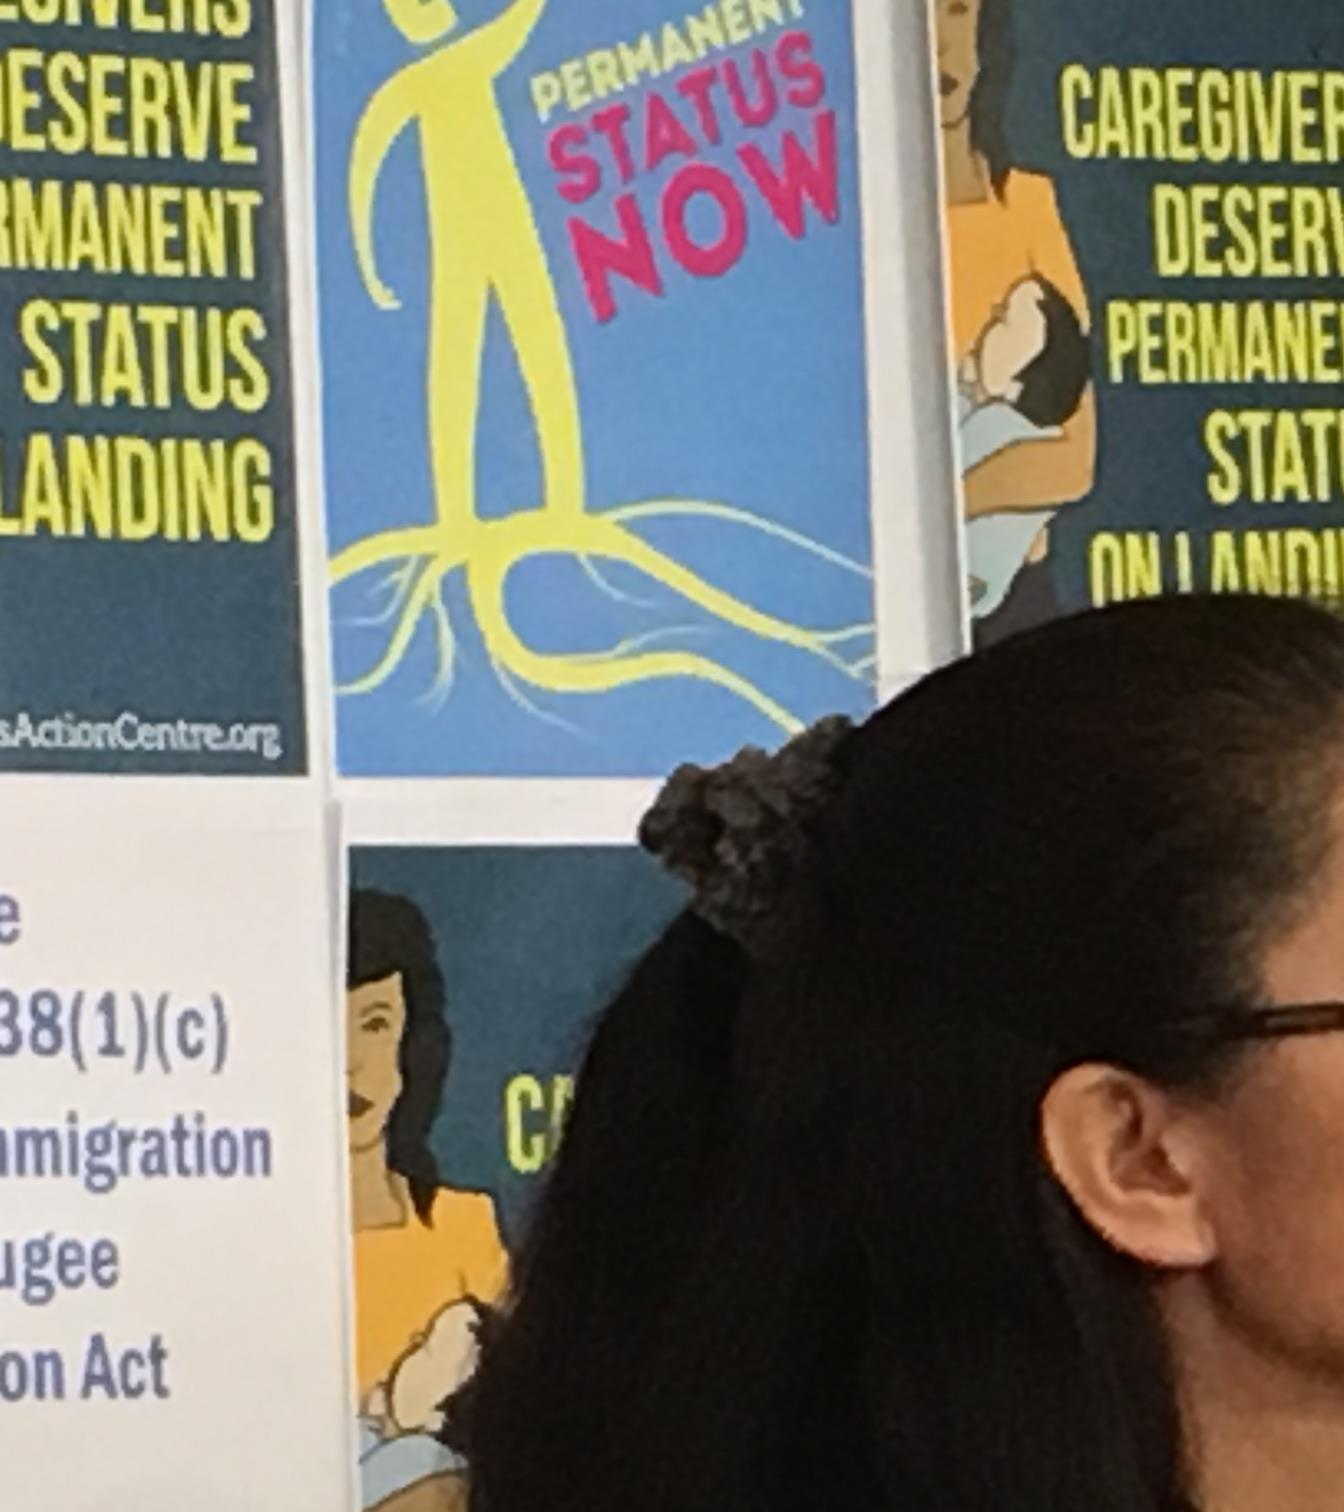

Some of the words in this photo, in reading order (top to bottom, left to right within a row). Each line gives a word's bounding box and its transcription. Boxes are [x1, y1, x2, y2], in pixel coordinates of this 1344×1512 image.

[0, 48, 257, 163] ESERVE
[548, 30, 826, 204] STATUS
[566, 109, 840, 324] NOW
[20, 299, 270, 413] STATUS
[1091, 531, 1162, 608] ON
[0, 1110, 272, 1194] migration
[81, 1332, 170, 1399] Act
